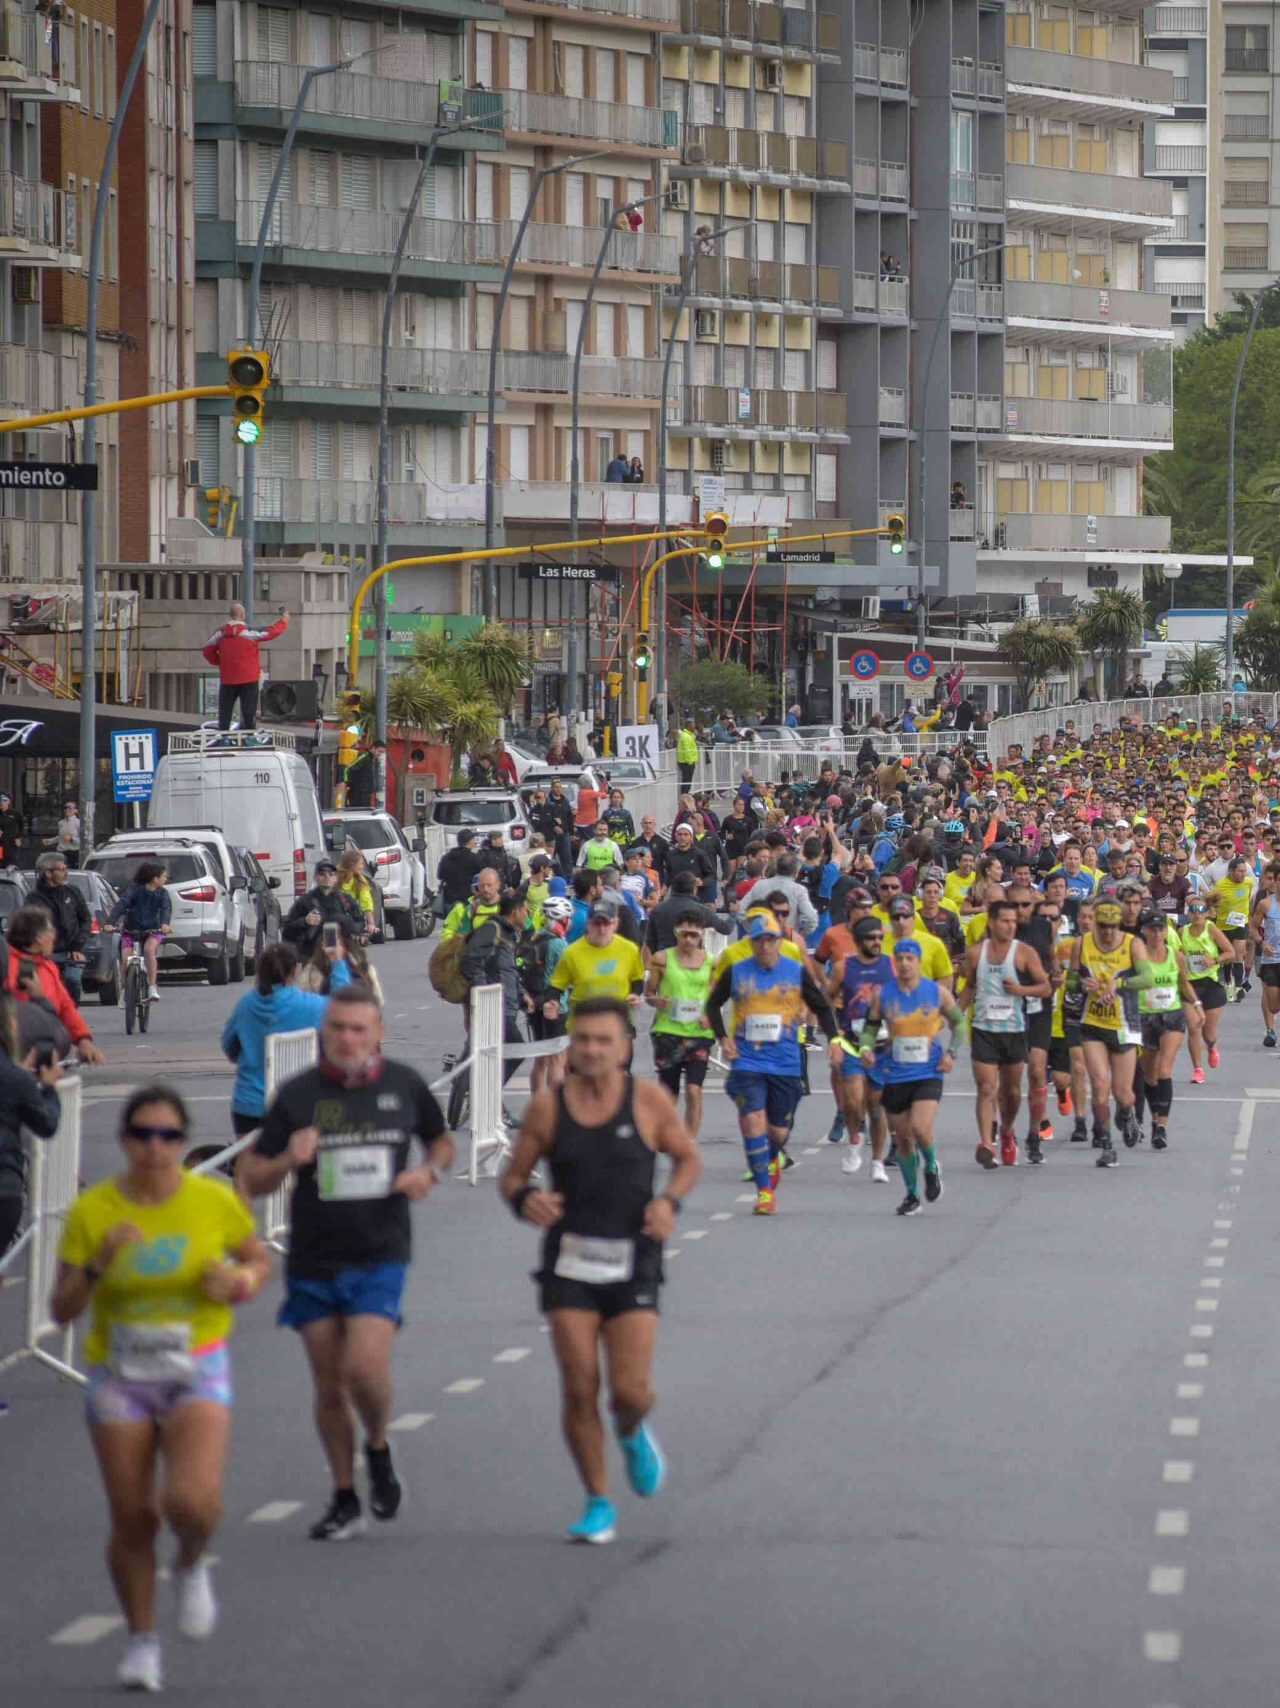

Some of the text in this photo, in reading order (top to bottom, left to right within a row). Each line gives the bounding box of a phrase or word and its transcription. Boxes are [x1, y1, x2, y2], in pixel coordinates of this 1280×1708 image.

[0, 466, 65, 486] miento
[780, 553, 821, 562] Lamadrid
[538, 565, 596, 578] Las Heras
[624, 735, 651, 759] 3K
[124, 741, 146, 771] H
[253, 771, 271, 785] 110
